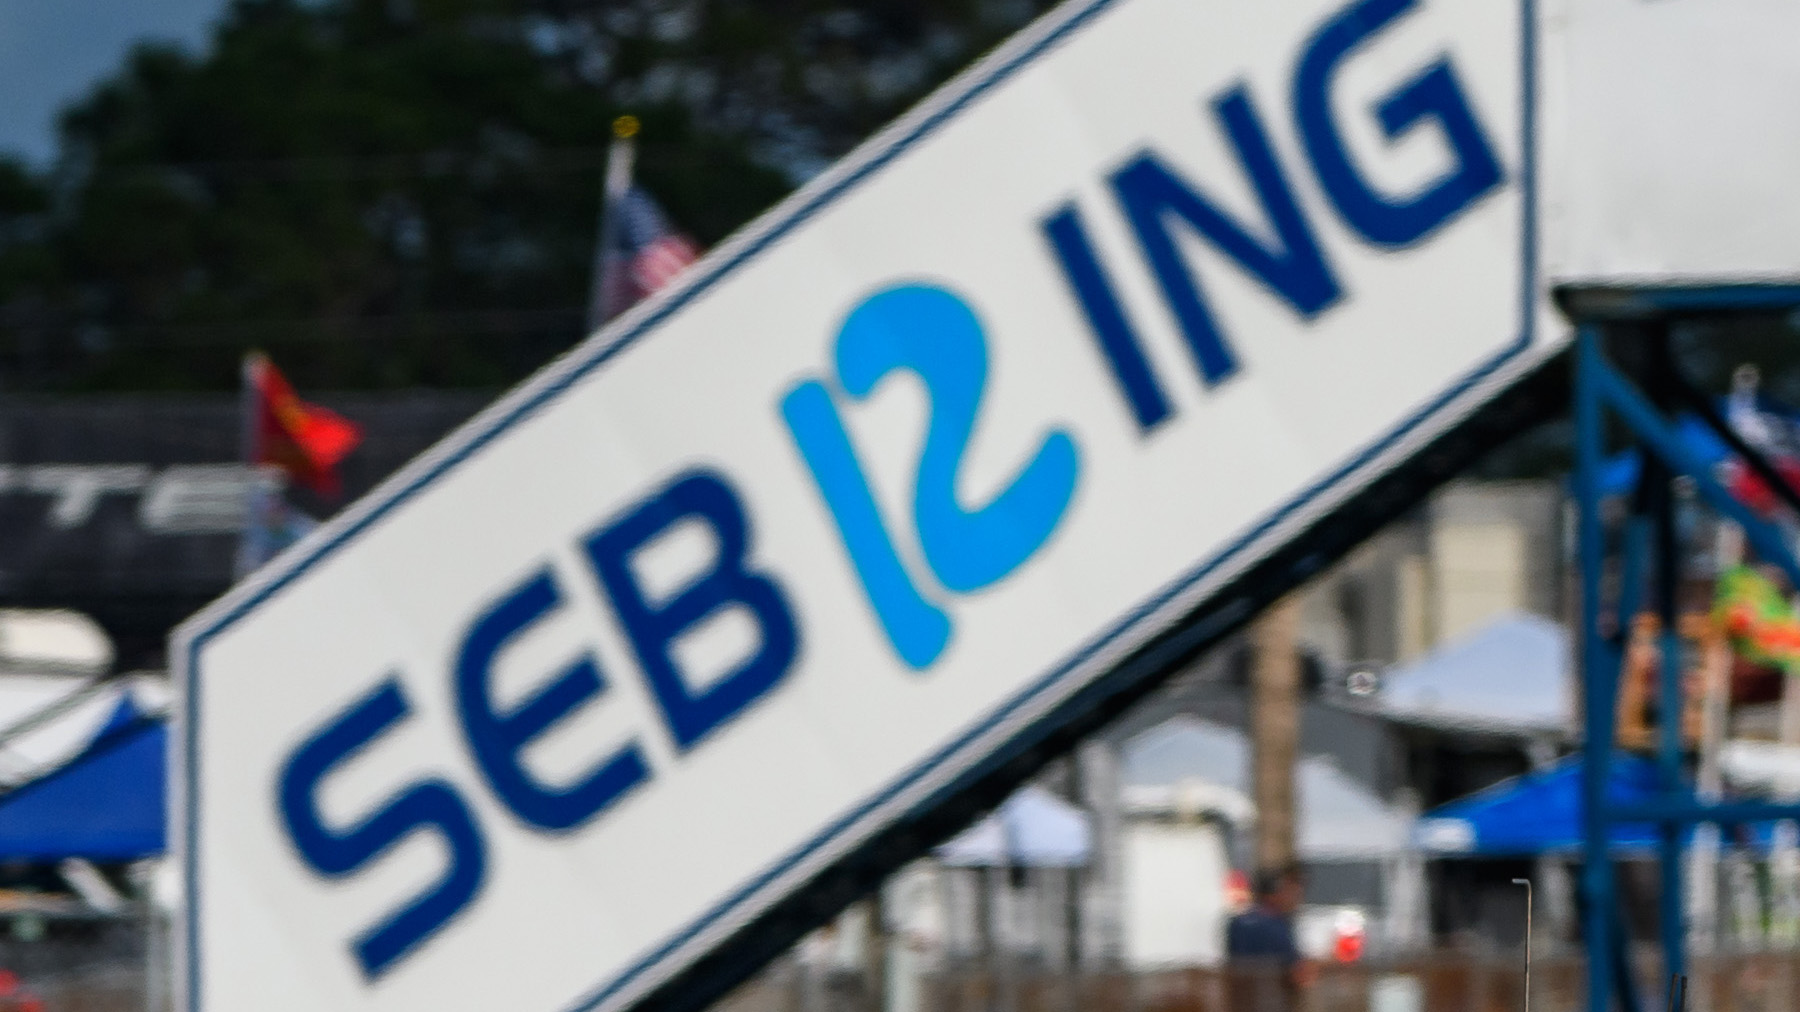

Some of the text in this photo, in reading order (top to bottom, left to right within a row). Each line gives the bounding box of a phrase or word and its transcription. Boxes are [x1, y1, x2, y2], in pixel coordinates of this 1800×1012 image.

[273, 0, 1509, 984] SEB 12 ING
